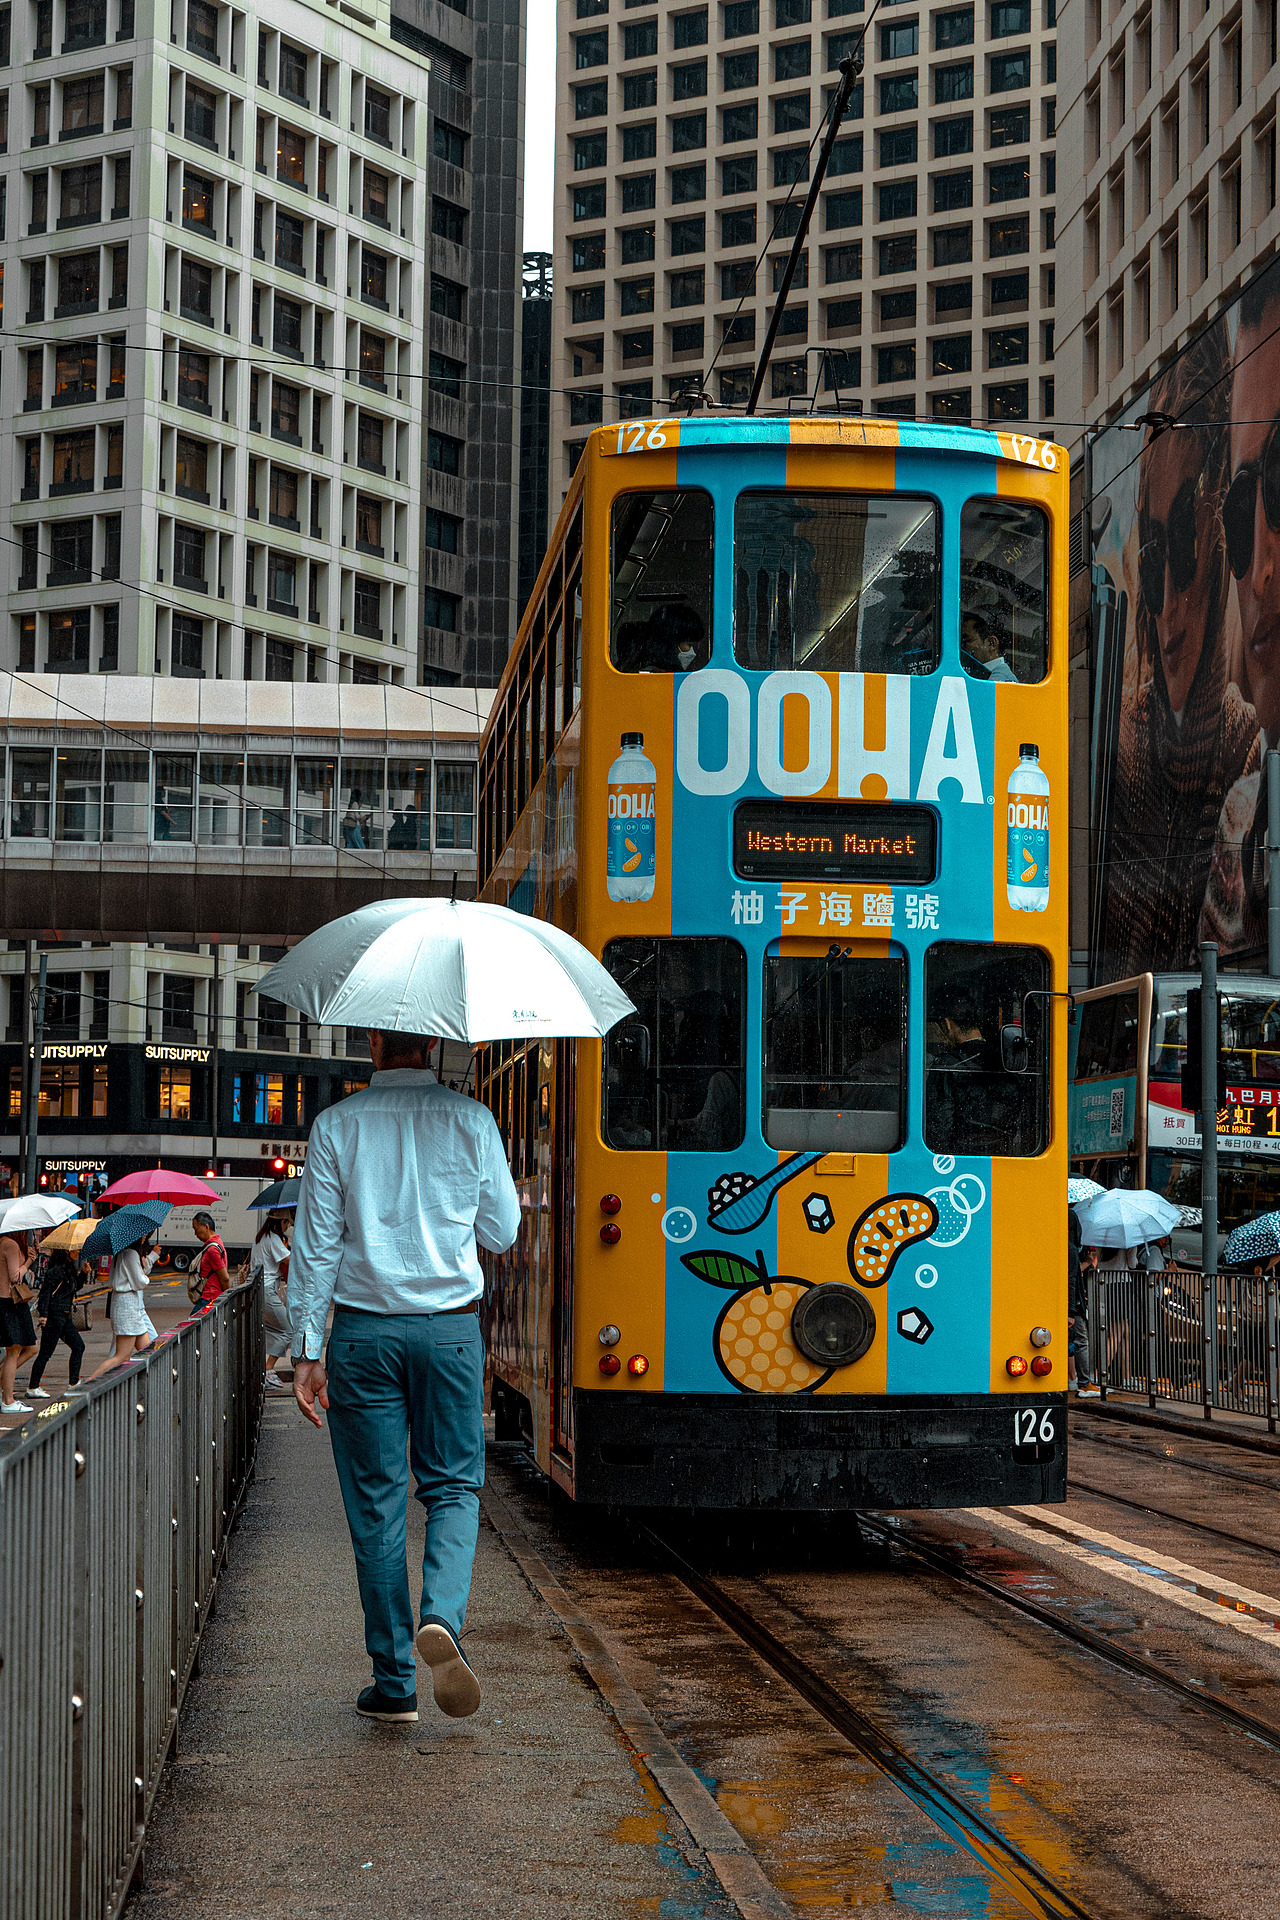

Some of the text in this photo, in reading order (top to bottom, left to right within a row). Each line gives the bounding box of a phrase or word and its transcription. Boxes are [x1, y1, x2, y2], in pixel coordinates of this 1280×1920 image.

[617, 422, 667, 454] 126
[1012, 435, 1057, 470] 126
[677, 668, 985, 804] OOHA
[608, 793, 656, 819] OOHA
[1008, 803, 1049, 830] OOHA
[748, 831, 917, 855] Western Market
[731, 890, 940, 930] 柚子海鹽號
[145, 1045, 210, 1063] SUITSUPPLY
[1226, 1088, 1280, 1105] 九巴月
[45, 1160, 107, 1171] SUITSUPPLY
[1014, 1408, 1055, 1447] 126
